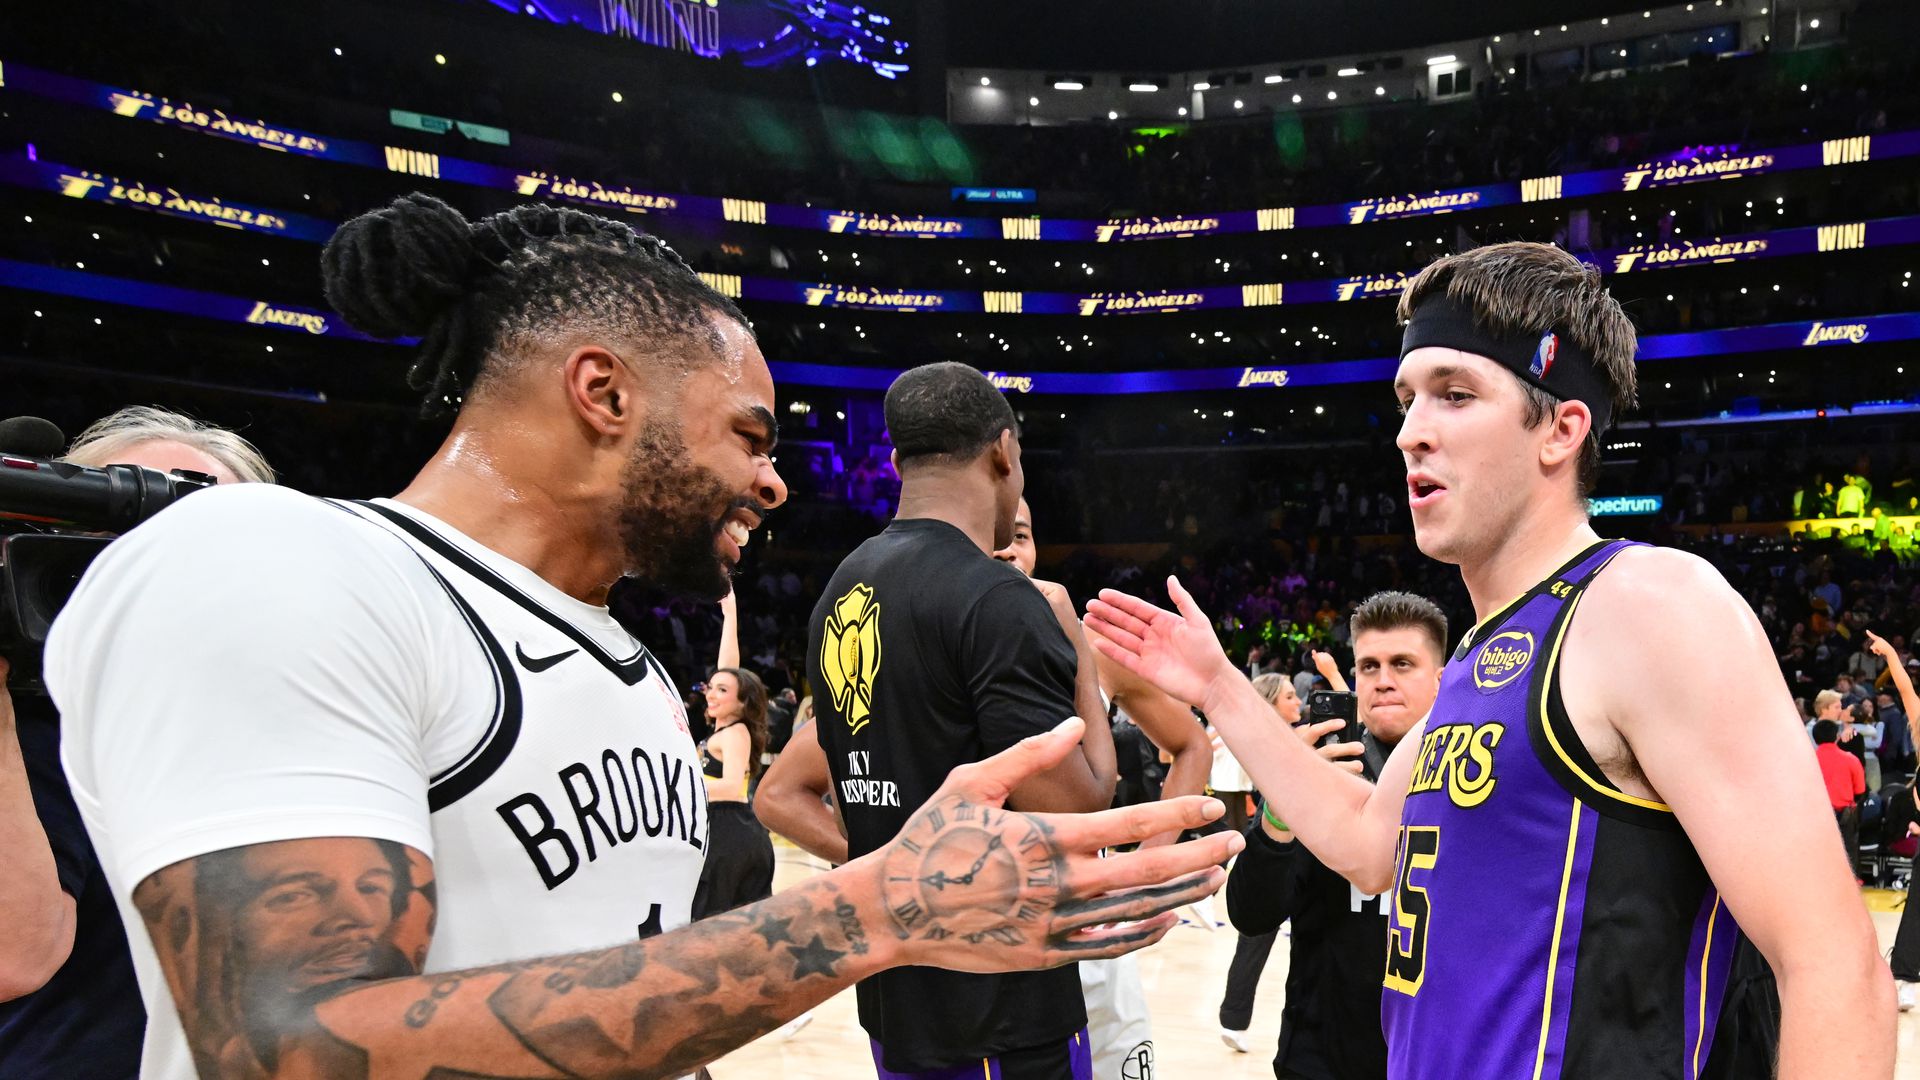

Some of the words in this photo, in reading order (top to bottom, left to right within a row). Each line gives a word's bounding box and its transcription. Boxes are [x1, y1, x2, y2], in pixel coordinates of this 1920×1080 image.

[159, 100, 209, 126] LOS
[385, 146, 440, 179] WIN!
[1822, 135, 1871, 166] WIN!
[1654, 162, 1688, 181] LOS
[109, 180, 163, 206] LOS
[551, 178, 589, 199] LOS
[1521, 175, 1562, 203] WIN!
[722, 198, 767, 224] WIN!
[1375, 197, 1406, 216] LOS
[857, 214, 889, 231] LOS
[1002, 217, 1041, 240] WIN!
[1122, 219, 1150, 236] LOS
[1257, 207, 1295, 231] WIN!
[1817, 223, 1865, 252] WIN!
[1646, 245, 1681, 263] LOS
[836, 286, 868, 304] LOS
[1242, 283, 1283, 307] WIN!
[1364, 275, 1394, 292] LOS
[983, 291, 1023, 314] WIN!
[1105, 293, 1135, 310] LOS
[246, 301, 329, 334] LAKERS
[1802, 322, 1869, 346] LAKERS
[1237, 367, 1290, 387] LAKERS
[1551, 581, 1573, 598] 44
[1481, 646, 1528, 670] bibigo
[1406, 723, 1505, 808] KERS
[496, 747, 709, 891] BROOKL
[1383, 825, 1440, 997] 5
